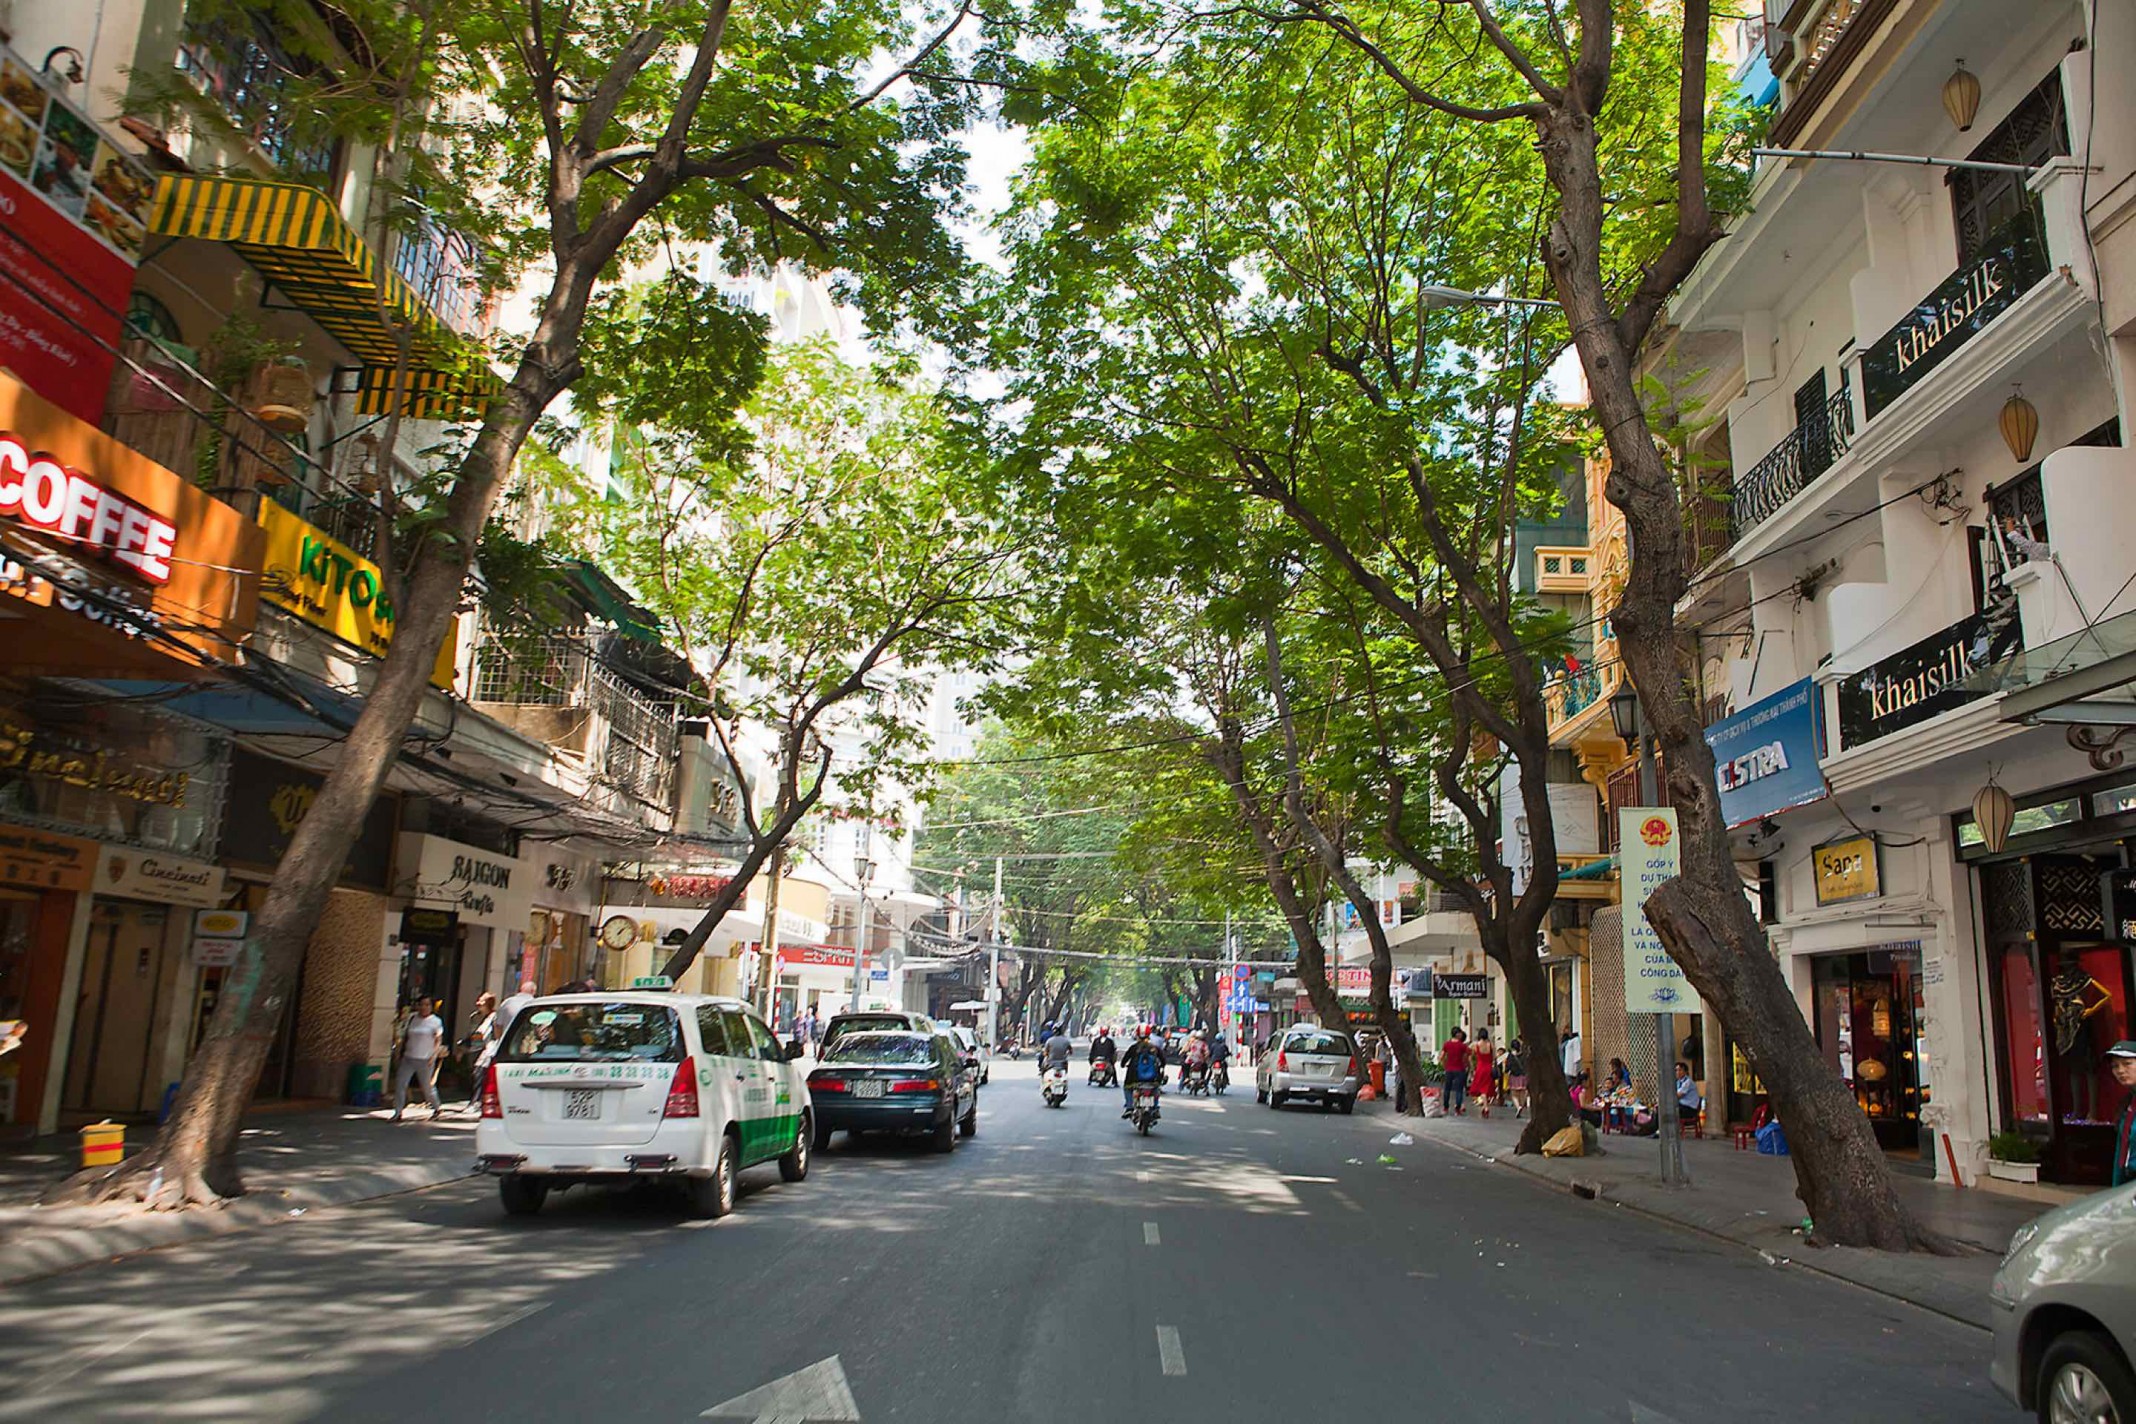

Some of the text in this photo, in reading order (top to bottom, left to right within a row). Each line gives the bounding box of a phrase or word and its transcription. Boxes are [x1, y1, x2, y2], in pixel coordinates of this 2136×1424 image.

[1894, 258, 2003, 374] khaisilk
[0, 440, 176, 581] COFFEE
[1871, 640, 1974, 721] khaisilk
[446, 856, 512, 890] SAIGON
[1823, 853, 1863, 880] Sapa
[1437, 978, 1486, 992] Armani
